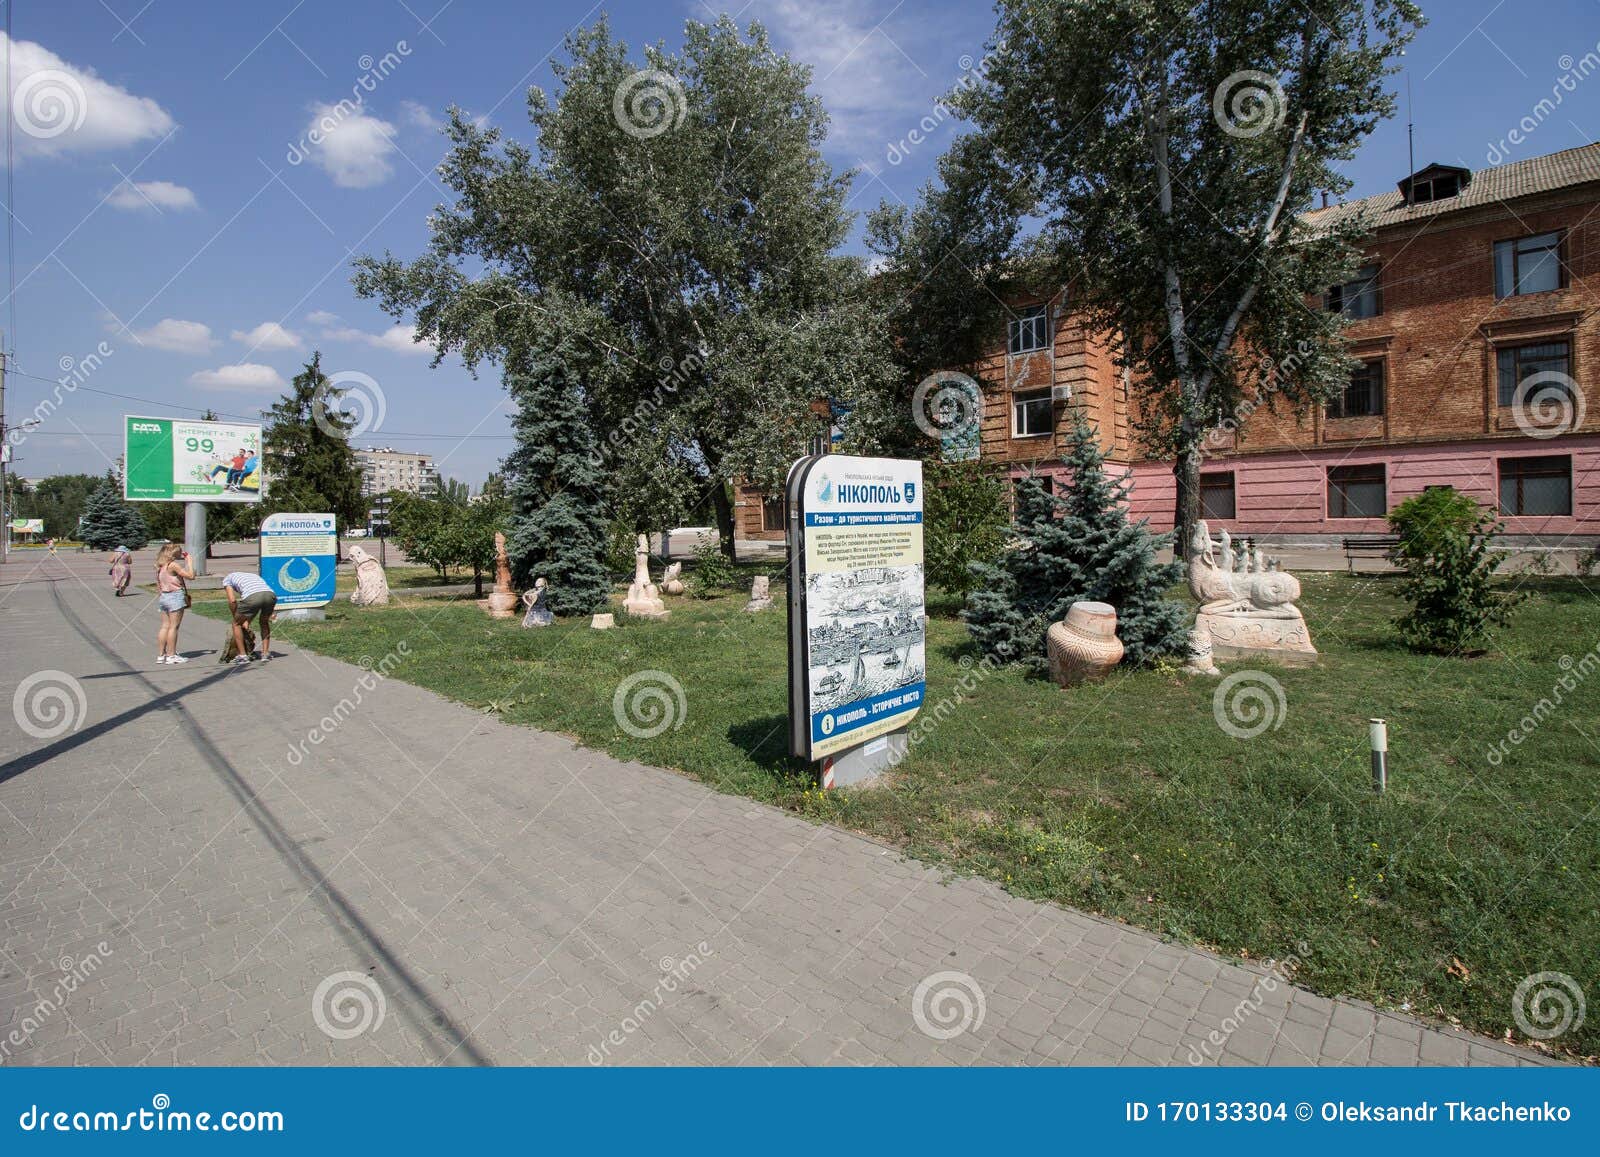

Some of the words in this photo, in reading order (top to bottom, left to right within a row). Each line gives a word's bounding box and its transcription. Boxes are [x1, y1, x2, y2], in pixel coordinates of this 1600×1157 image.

[186, 437, 214, 453] 99
[838, 484, 901, 503] НІКОПОЛЬ
[280, 521, 321, 529] НІКОПОЛЬ
[814, 514, 833, 524] Разом
[847, 515, 882, 524] туристичного
[836, 708, 867, 726] НІКОПОЛЬ
[872, 696, 902, 714] ІСТОРИЧНЕ
[903, 691, 919, 704] МІСТО
